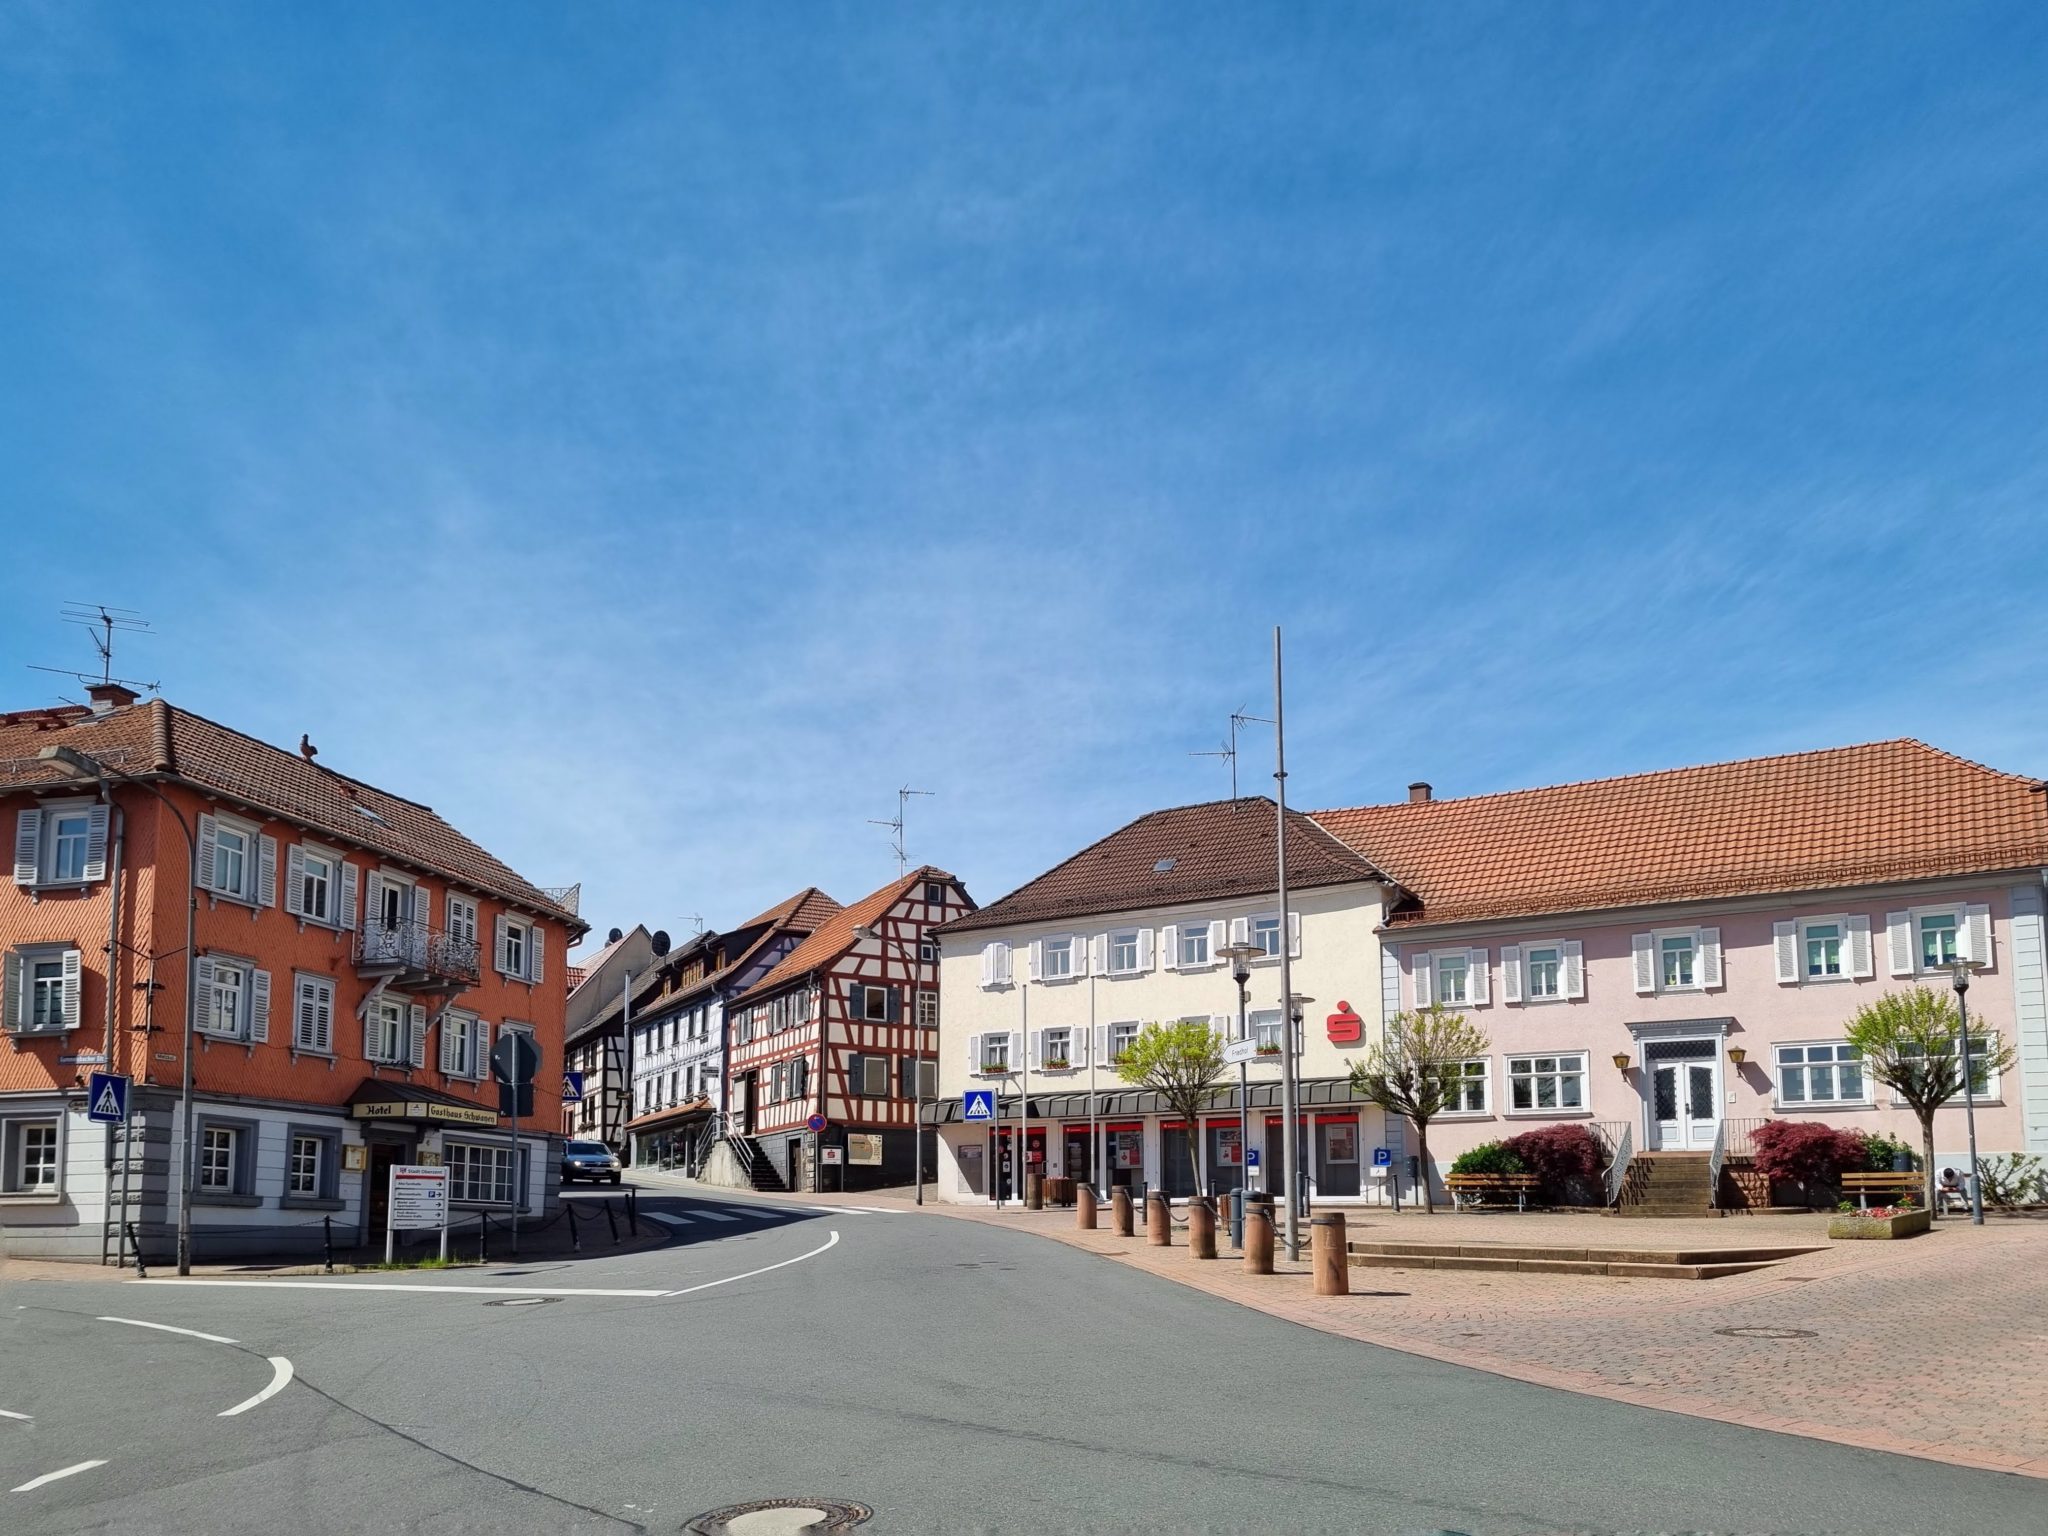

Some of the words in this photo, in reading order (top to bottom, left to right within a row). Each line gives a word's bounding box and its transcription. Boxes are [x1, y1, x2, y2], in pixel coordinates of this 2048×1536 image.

[366, 1104, 392, 1115] Hotel
[430, 1105, 462, 1118] Gasthaus
[463, 1110, 495, 1123] Schwanen
[1378, 1151, 1387, 1164] P
